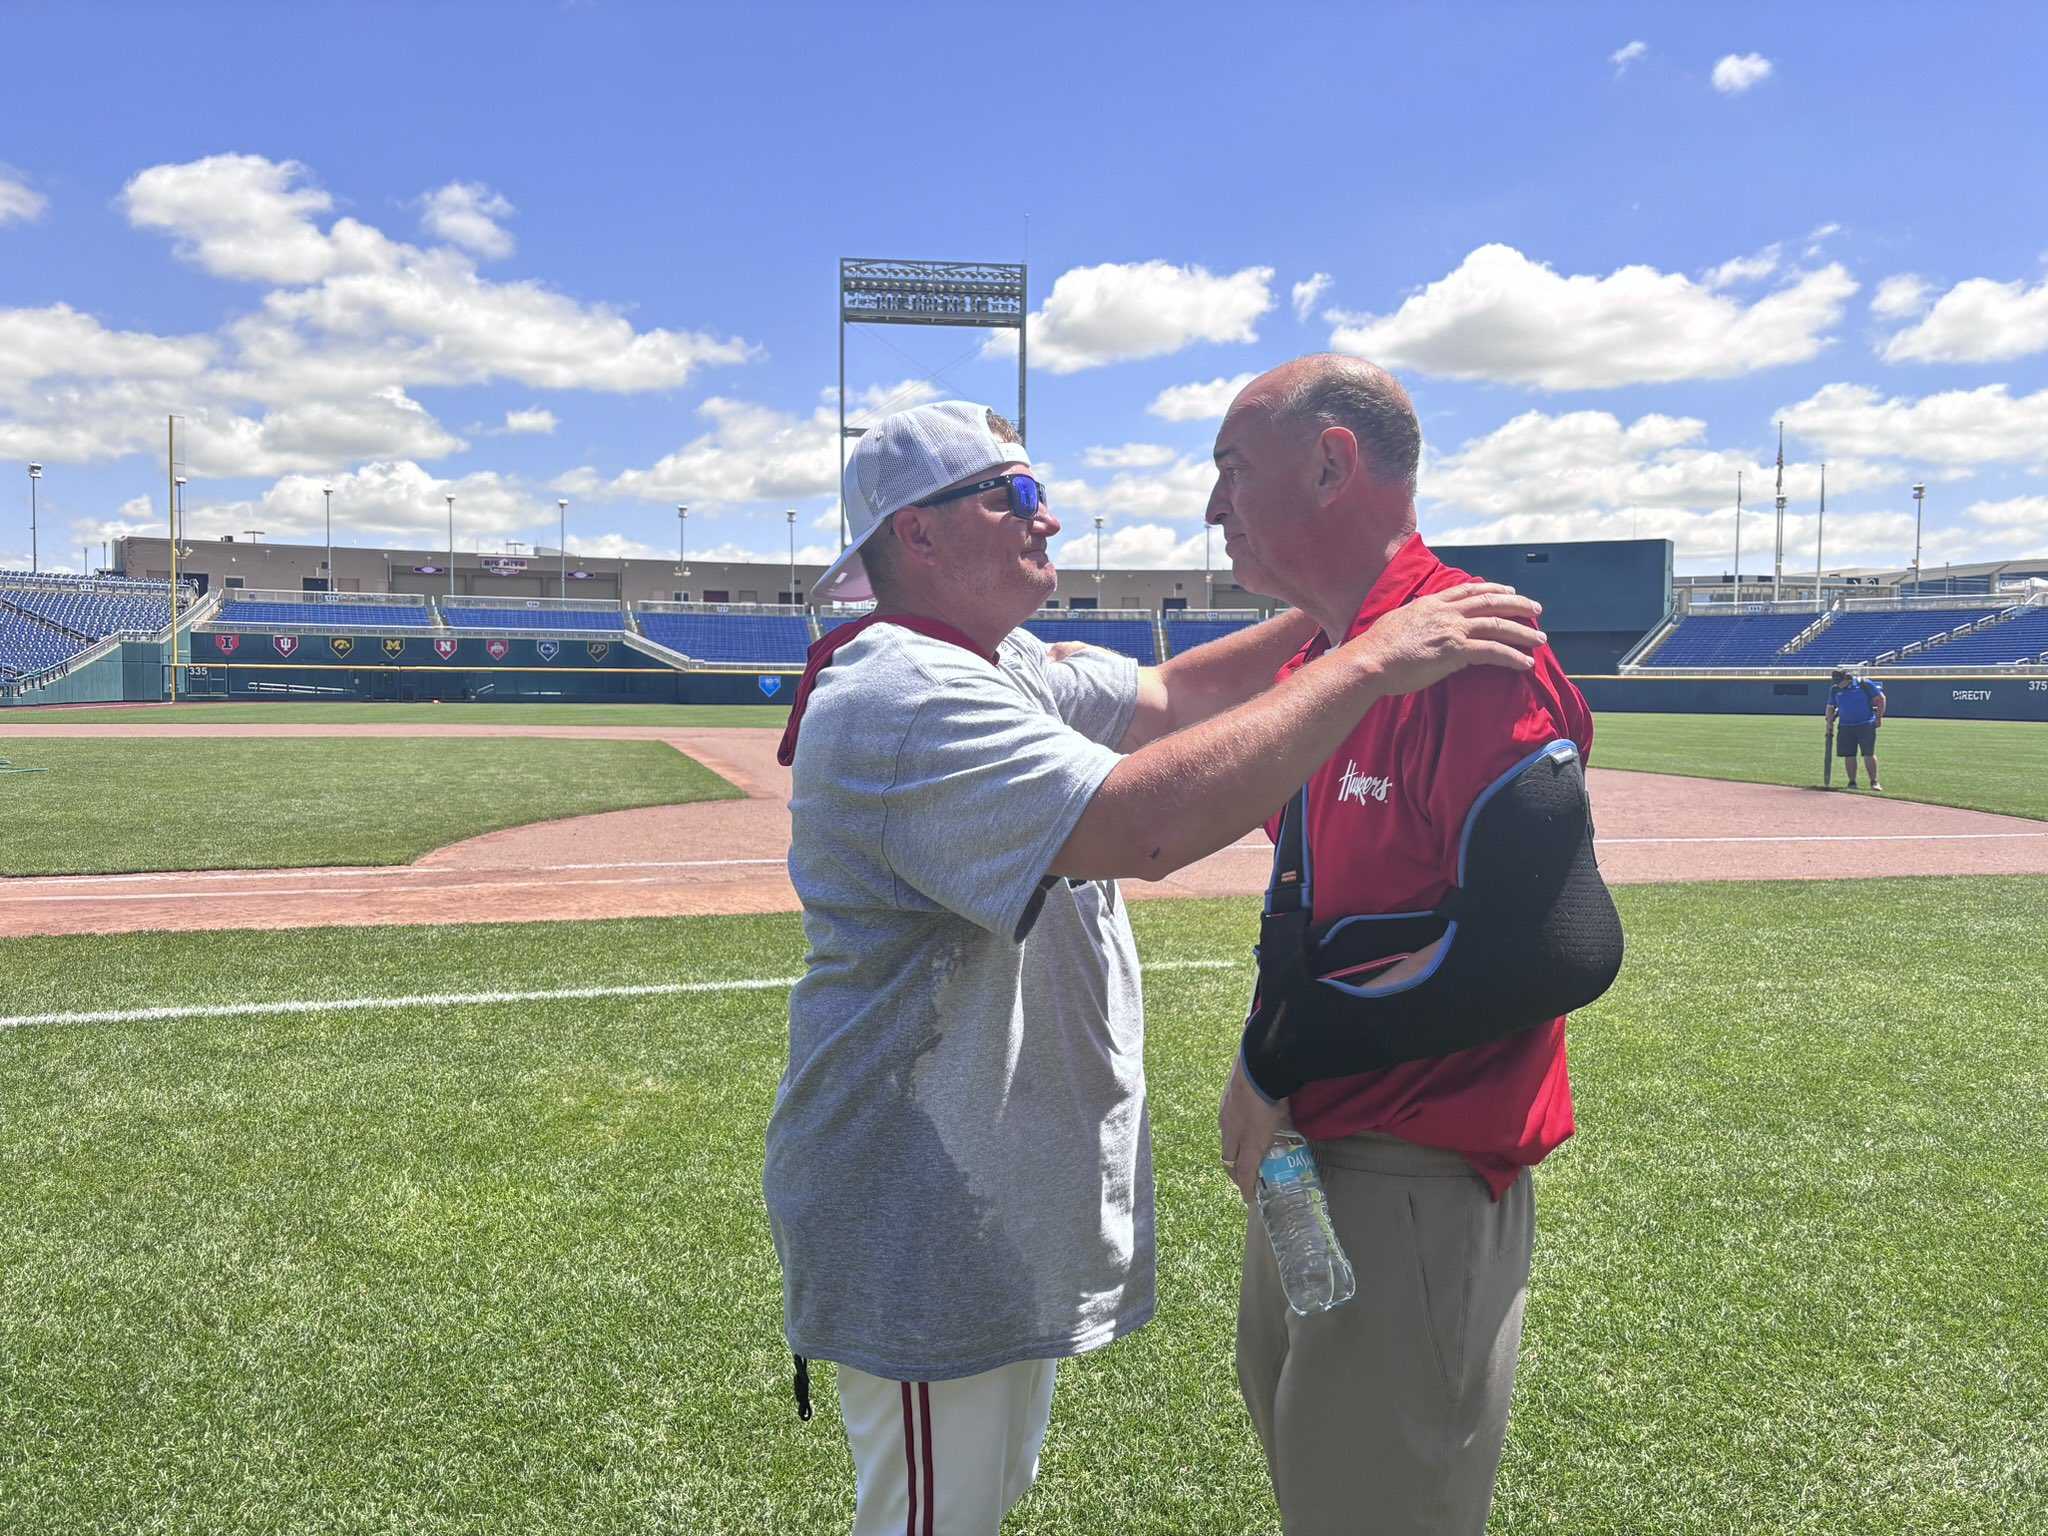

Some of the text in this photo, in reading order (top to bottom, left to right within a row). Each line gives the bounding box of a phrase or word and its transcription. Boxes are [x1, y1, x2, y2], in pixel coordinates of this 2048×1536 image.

[385, 640, 401, 650] M
[439, 641, 452, 652] N
[189, 666, 208, 676] 335
[2028, 681, 2048, 691] 375
[1952, 690, 1992, 701] DIRECTV
